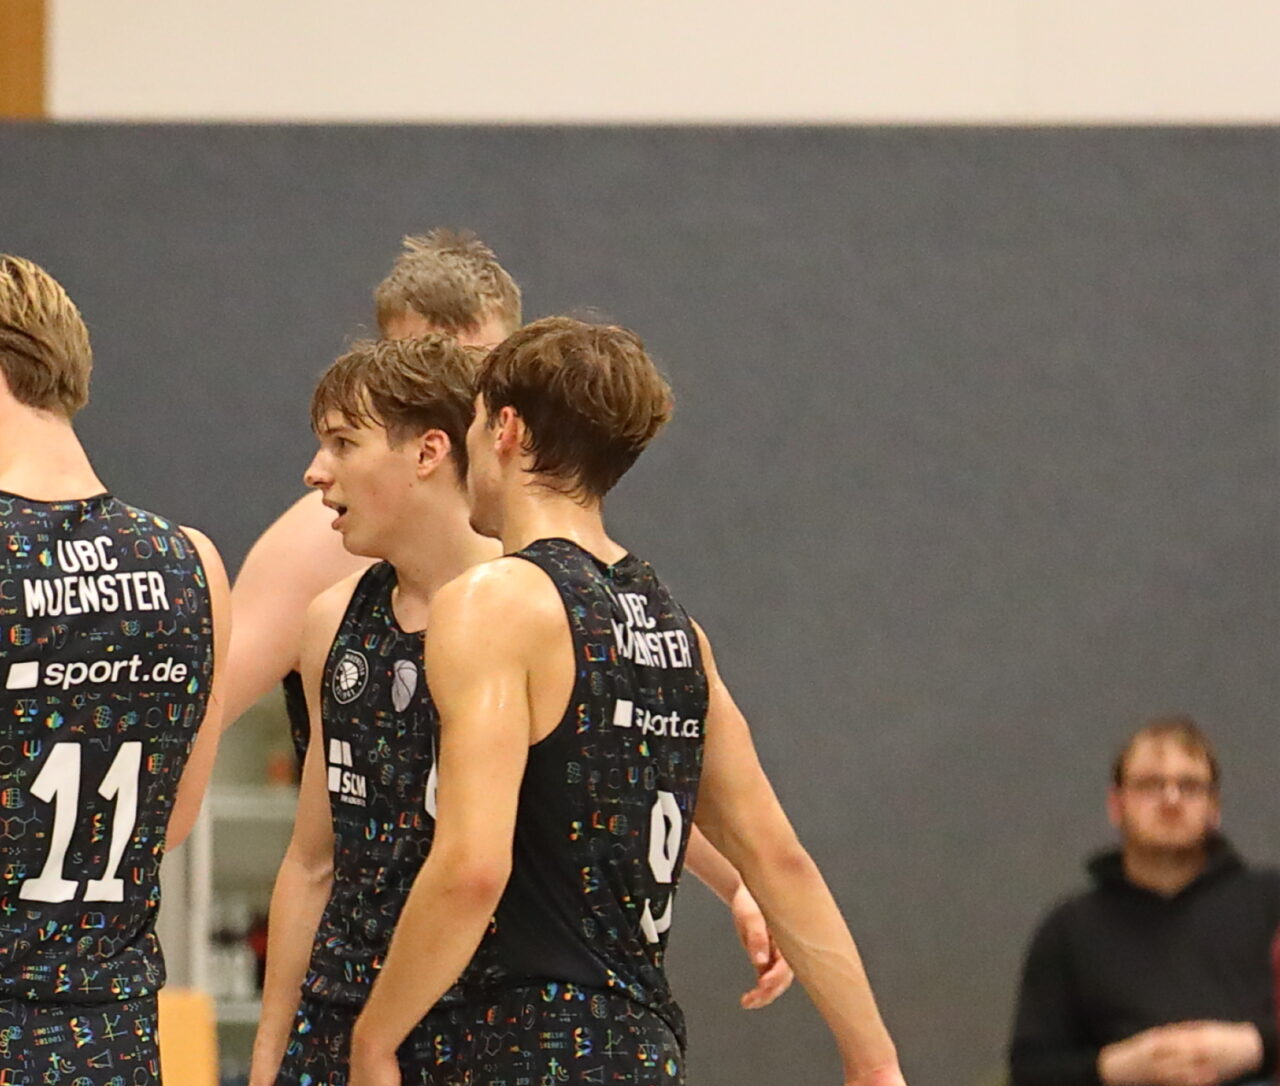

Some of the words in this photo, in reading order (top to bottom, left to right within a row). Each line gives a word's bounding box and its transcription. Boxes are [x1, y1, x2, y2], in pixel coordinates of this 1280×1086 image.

[57, 536, 118, 573] UBC
[23, 571, 169, 618] MUENSTER
[43, 655, 188, 690] sport.de
[19, 742, 142, 903] 11
